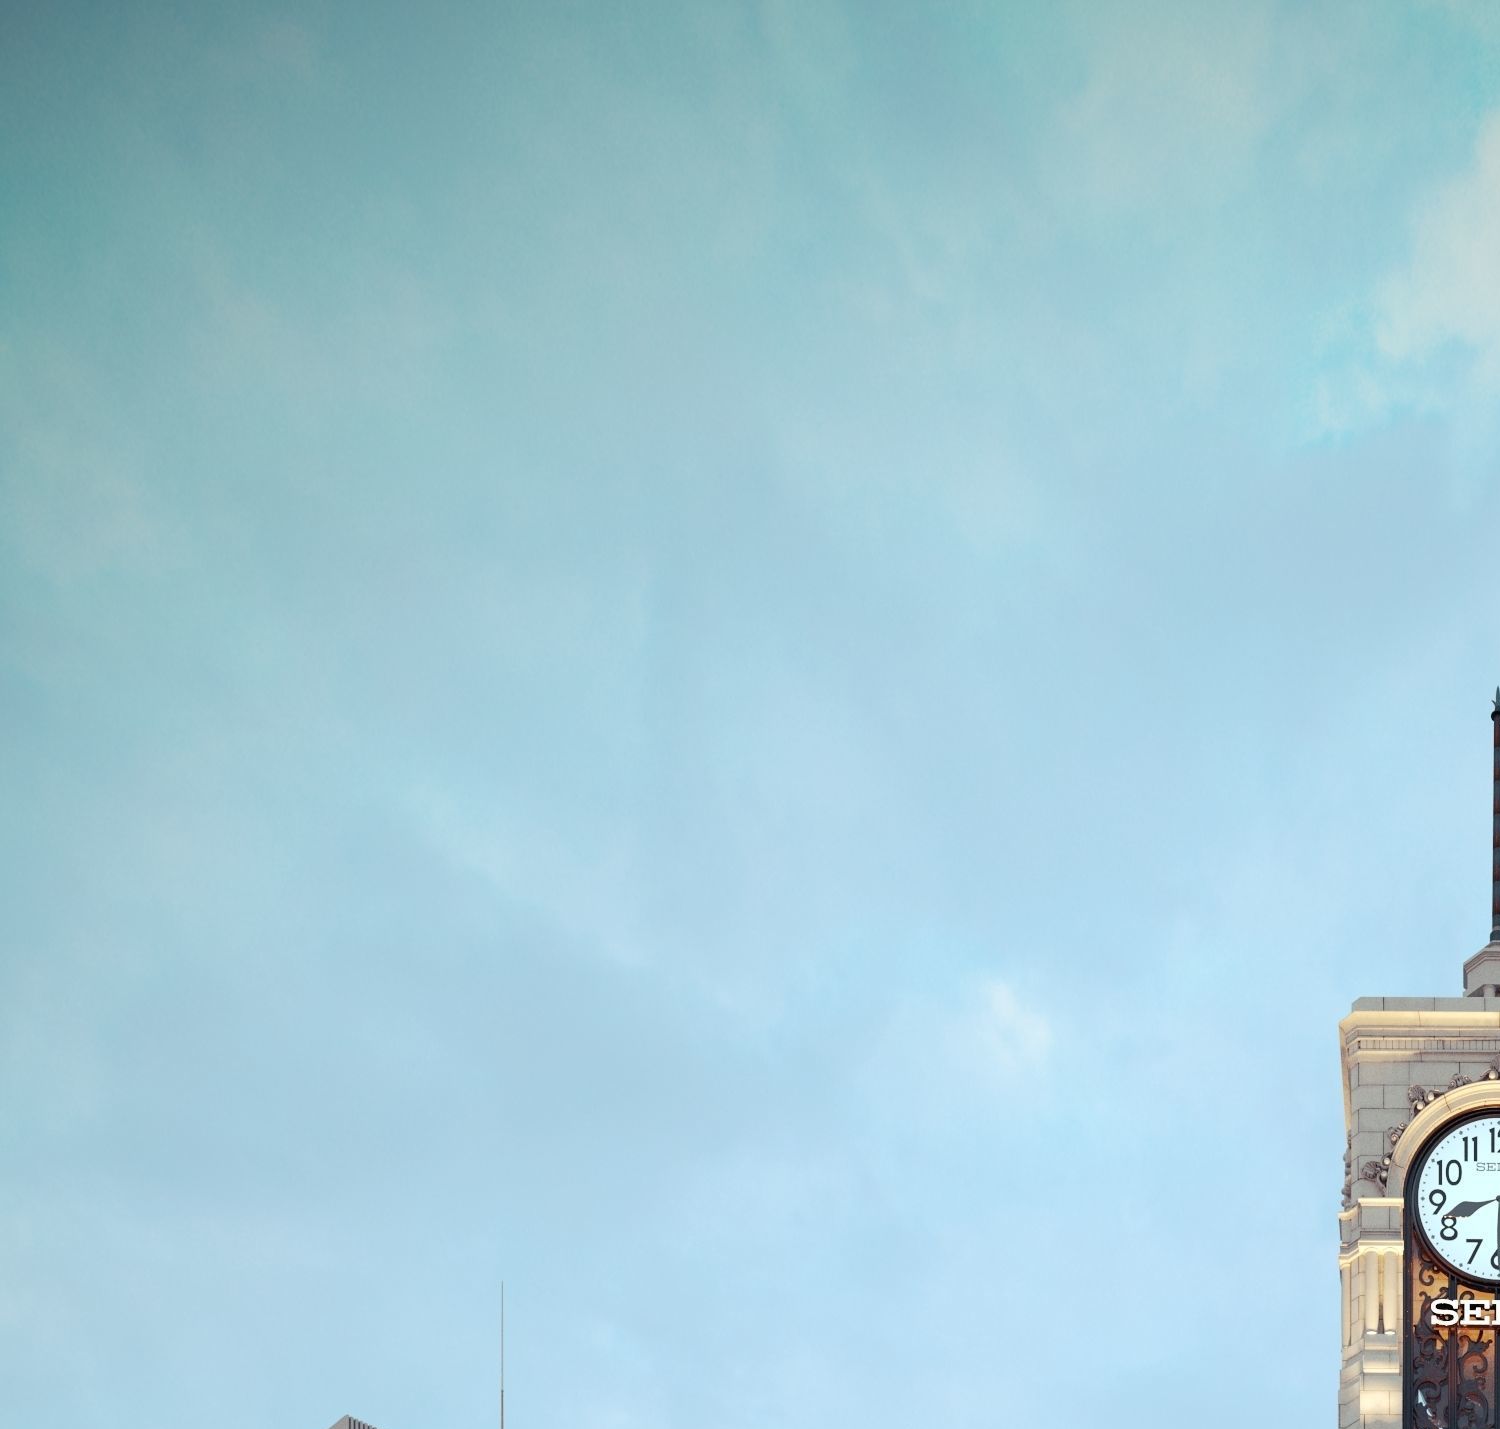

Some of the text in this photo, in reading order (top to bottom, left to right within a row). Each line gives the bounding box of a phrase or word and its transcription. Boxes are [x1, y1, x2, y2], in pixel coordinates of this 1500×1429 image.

[1462, 1136, 1478, 1162] 11
[1436, 1159, 1463, 1186] 10
[1428, 1189, 1447, 1215] 9
[1440, 1214, 1458, 1241] 8
[1466, 1238, 1484, 1264] 7
